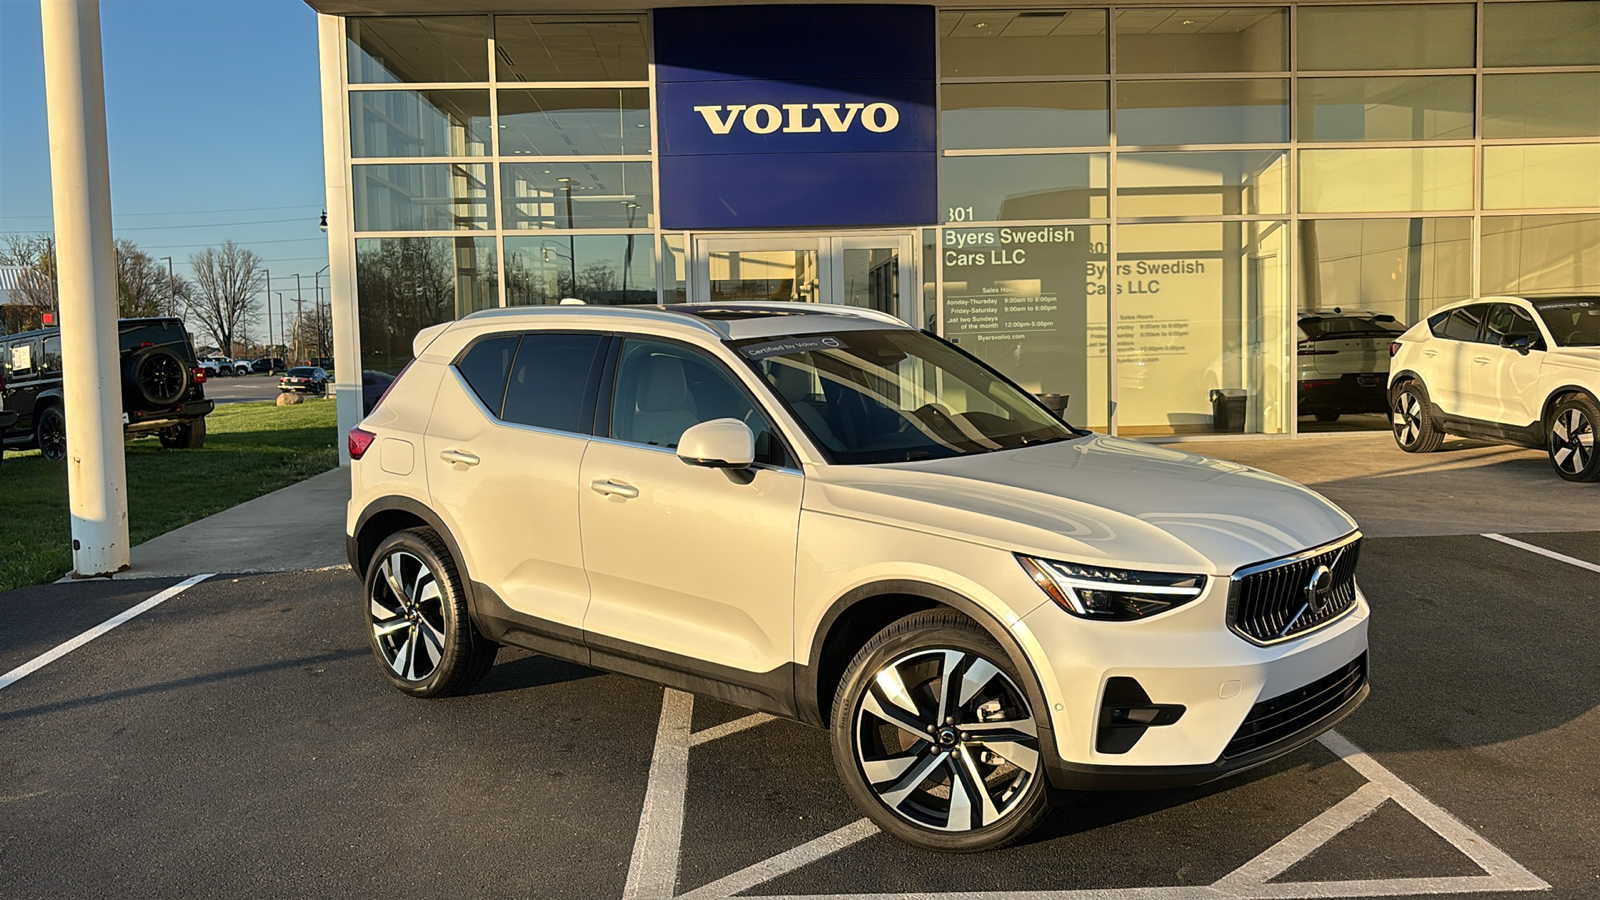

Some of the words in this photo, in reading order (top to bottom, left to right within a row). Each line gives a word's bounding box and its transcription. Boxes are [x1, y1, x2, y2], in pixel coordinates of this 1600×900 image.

[693, 102, 900, 135] VOLVO
[945, 230, 995, 249] Byers
[1000, 227, 1075, 244] Swedish
[945, 251, 985, 267] Cars
[991, 249, 1026, 265] LLC
[1136, 260, 1205, 275] Swedish
[1128, 280, 1160, 294] LLC
[977, 334, 1025, 342] Byersvolvo.com
[748, 345, 784, 356] Certified
